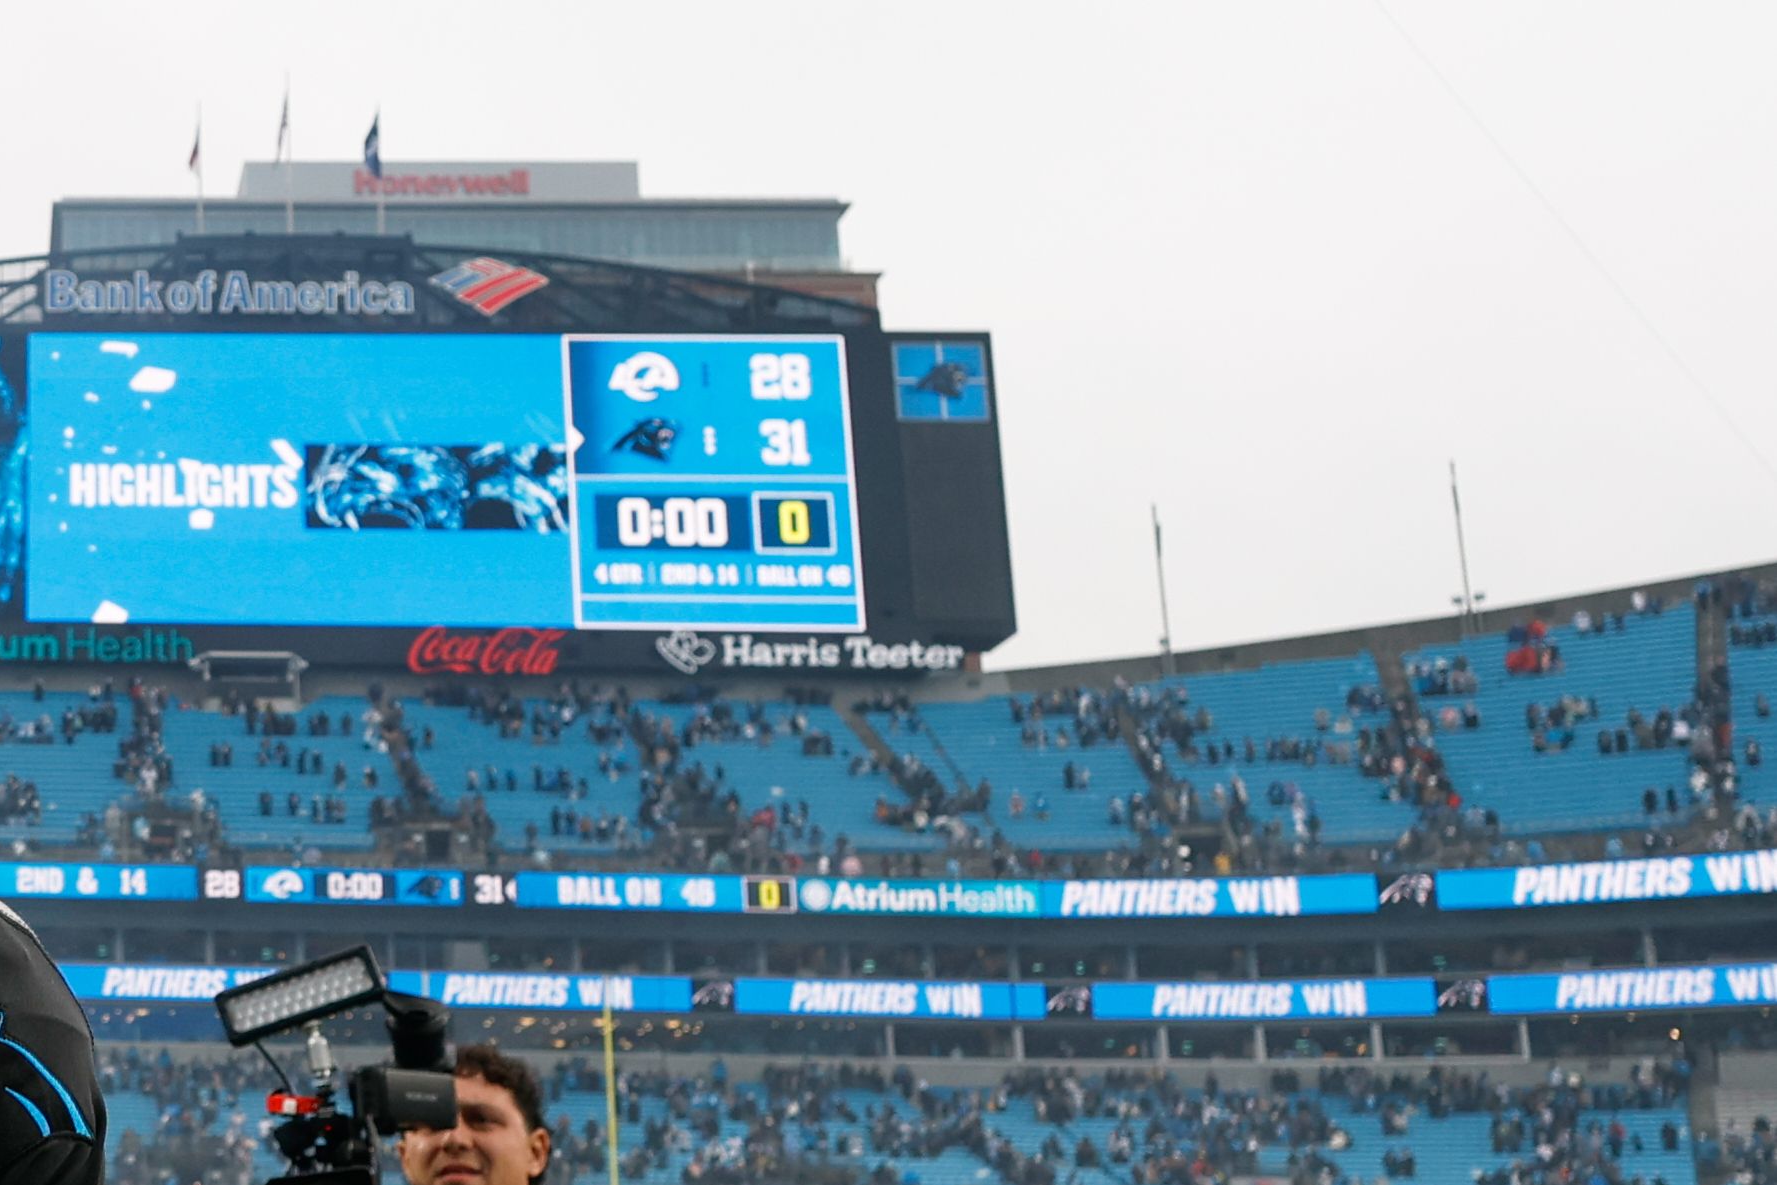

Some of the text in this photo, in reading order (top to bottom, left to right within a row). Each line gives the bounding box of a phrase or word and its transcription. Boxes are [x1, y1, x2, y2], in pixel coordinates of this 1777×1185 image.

[353, 168, 531, 194] Honeywell
[45, 269, 416, 314] Bank of America
[749, 353, 812, 400] 28
[759, 418, 811, 466] 31
[70, 463, 299, 507] HIGHLIGHTS
[617, 497, 729, 547] 0:00
[778, 499, 810, 545] 0
[66, 626, 195, 662] Health
[406, 624, 570, 676] Coca-Cola
[721, 634, 964, 668] Harris Teeter
[16, 866, 147, 896] 2ND & 14
[205, 869, 241, 899] 28
[327, 871, 384, 900] 0:00
[474, 874, 505, 904] 31
[557, 876, 621, 906] BALL
[830, 882, 1035, 913] Atrium Health
[1061, 876, 1301, 917] PANTHERS WIN
[1513, 857, 1693, 905] PANTHERS
[102, 966, 226, 999] PANTHERS
[441, 974, 634, 1009] PANTHERS WIN
[790, 981, 983, 1018] PANTHERS WIN
[1152, 980, 1368, 1017] PANTHERS WIN
[1556, 963, 1777, 1008] PANTHERS WI
